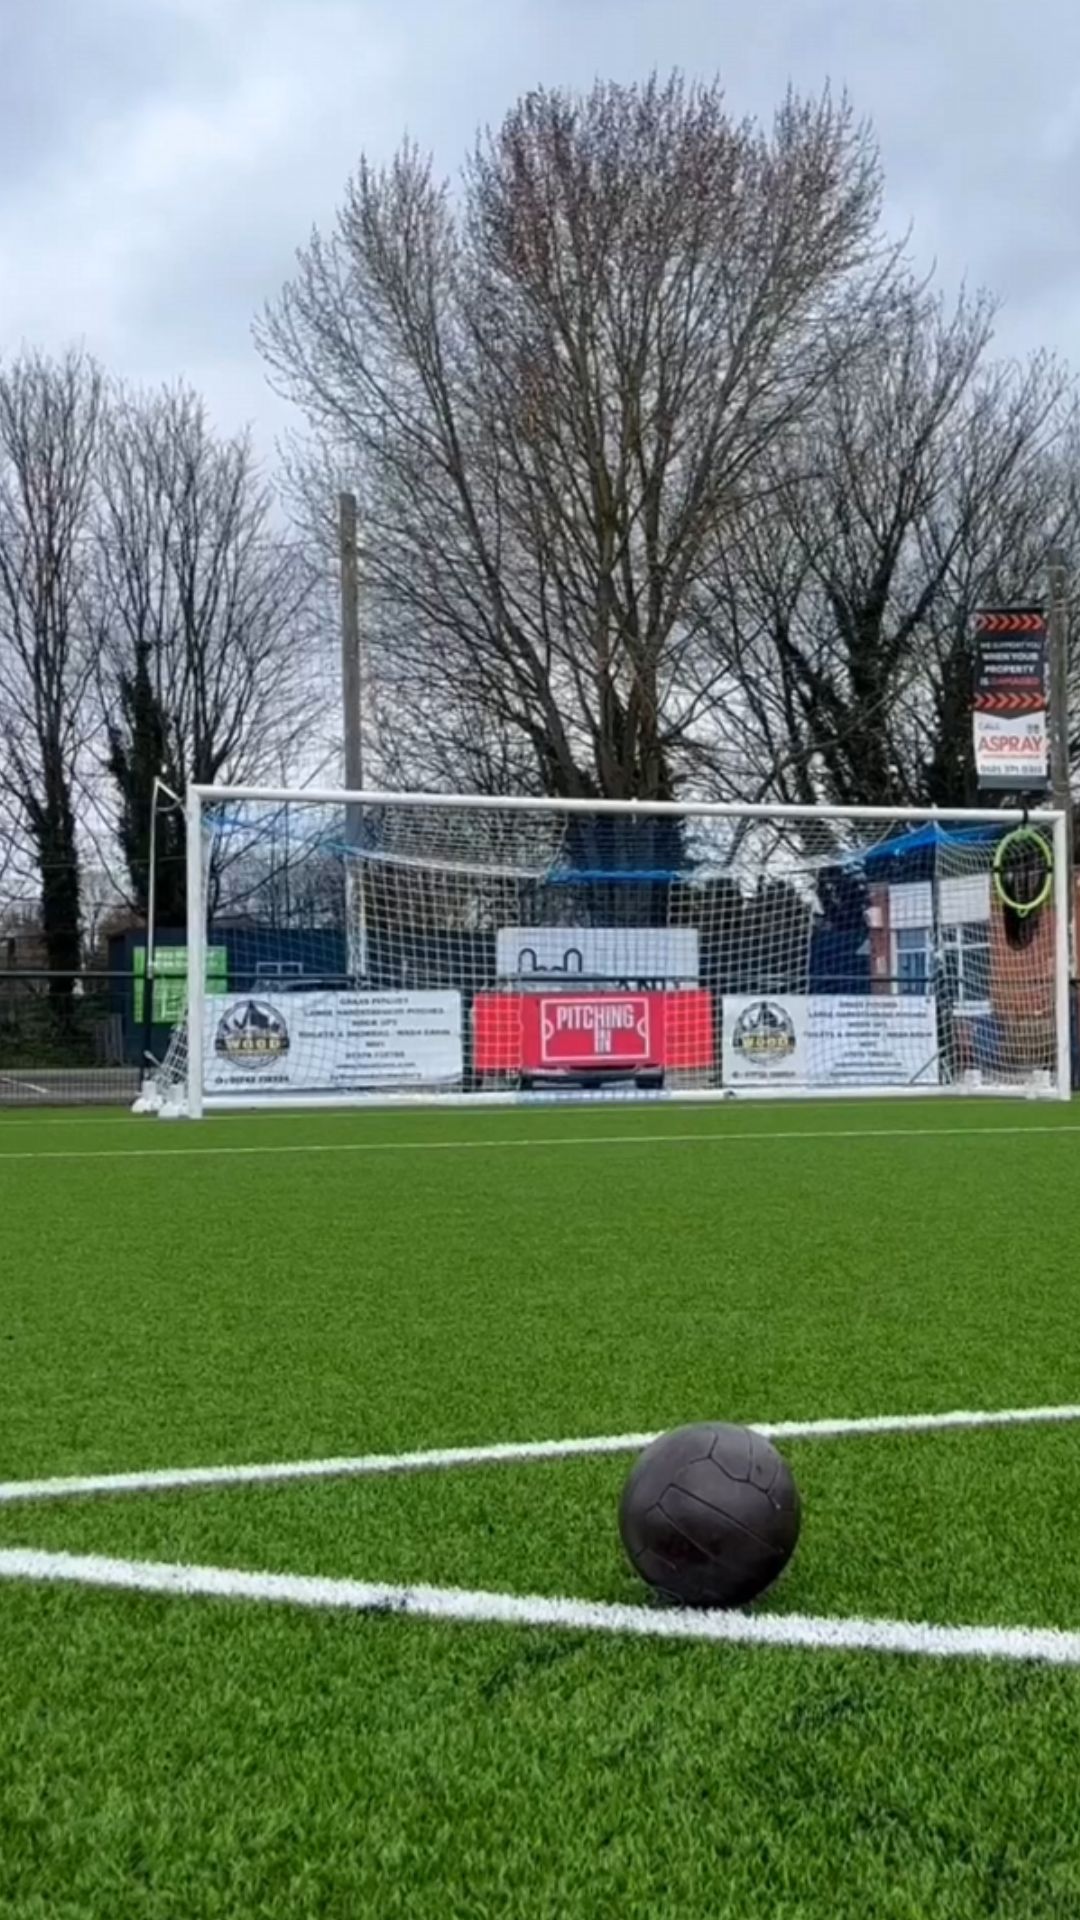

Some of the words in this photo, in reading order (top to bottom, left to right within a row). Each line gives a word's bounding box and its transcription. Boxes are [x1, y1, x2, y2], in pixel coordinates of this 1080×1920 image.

[983, 652, 1009, 661] WHEN
[1010, 652, 1039, 661] YOUR
[984, 664, 1035, 674] PROPERTY
[978, 735, 1043, 752] ASPRAY
[557, 1004, 634, 1029] PITCHING
[226, 1038, 280, 1049] WOOD
[594, 1029, 611, 1053] IN
